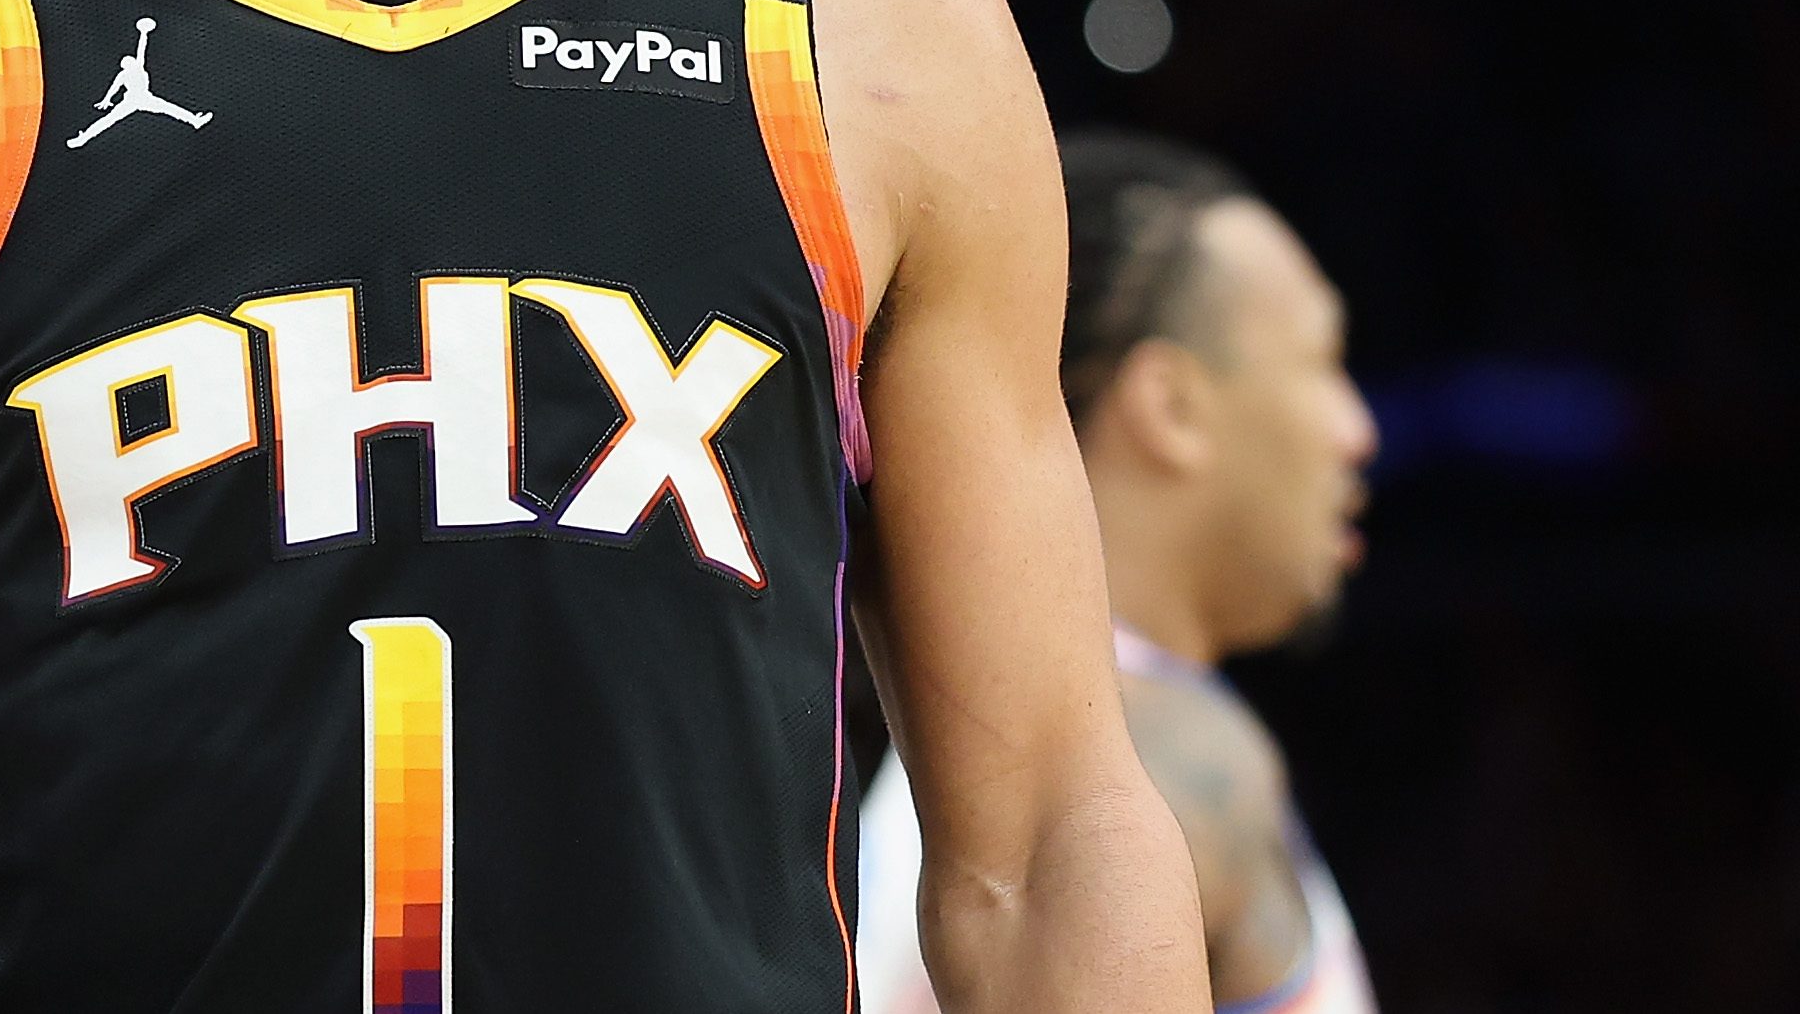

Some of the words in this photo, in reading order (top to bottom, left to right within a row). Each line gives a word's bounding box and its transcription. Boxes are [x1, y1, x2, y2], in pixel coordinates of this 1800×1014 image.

[520, 25, 723, 84] PayPal
[4, 274, 785, 606] PHX
[348, 616, 454, 1014] 1
